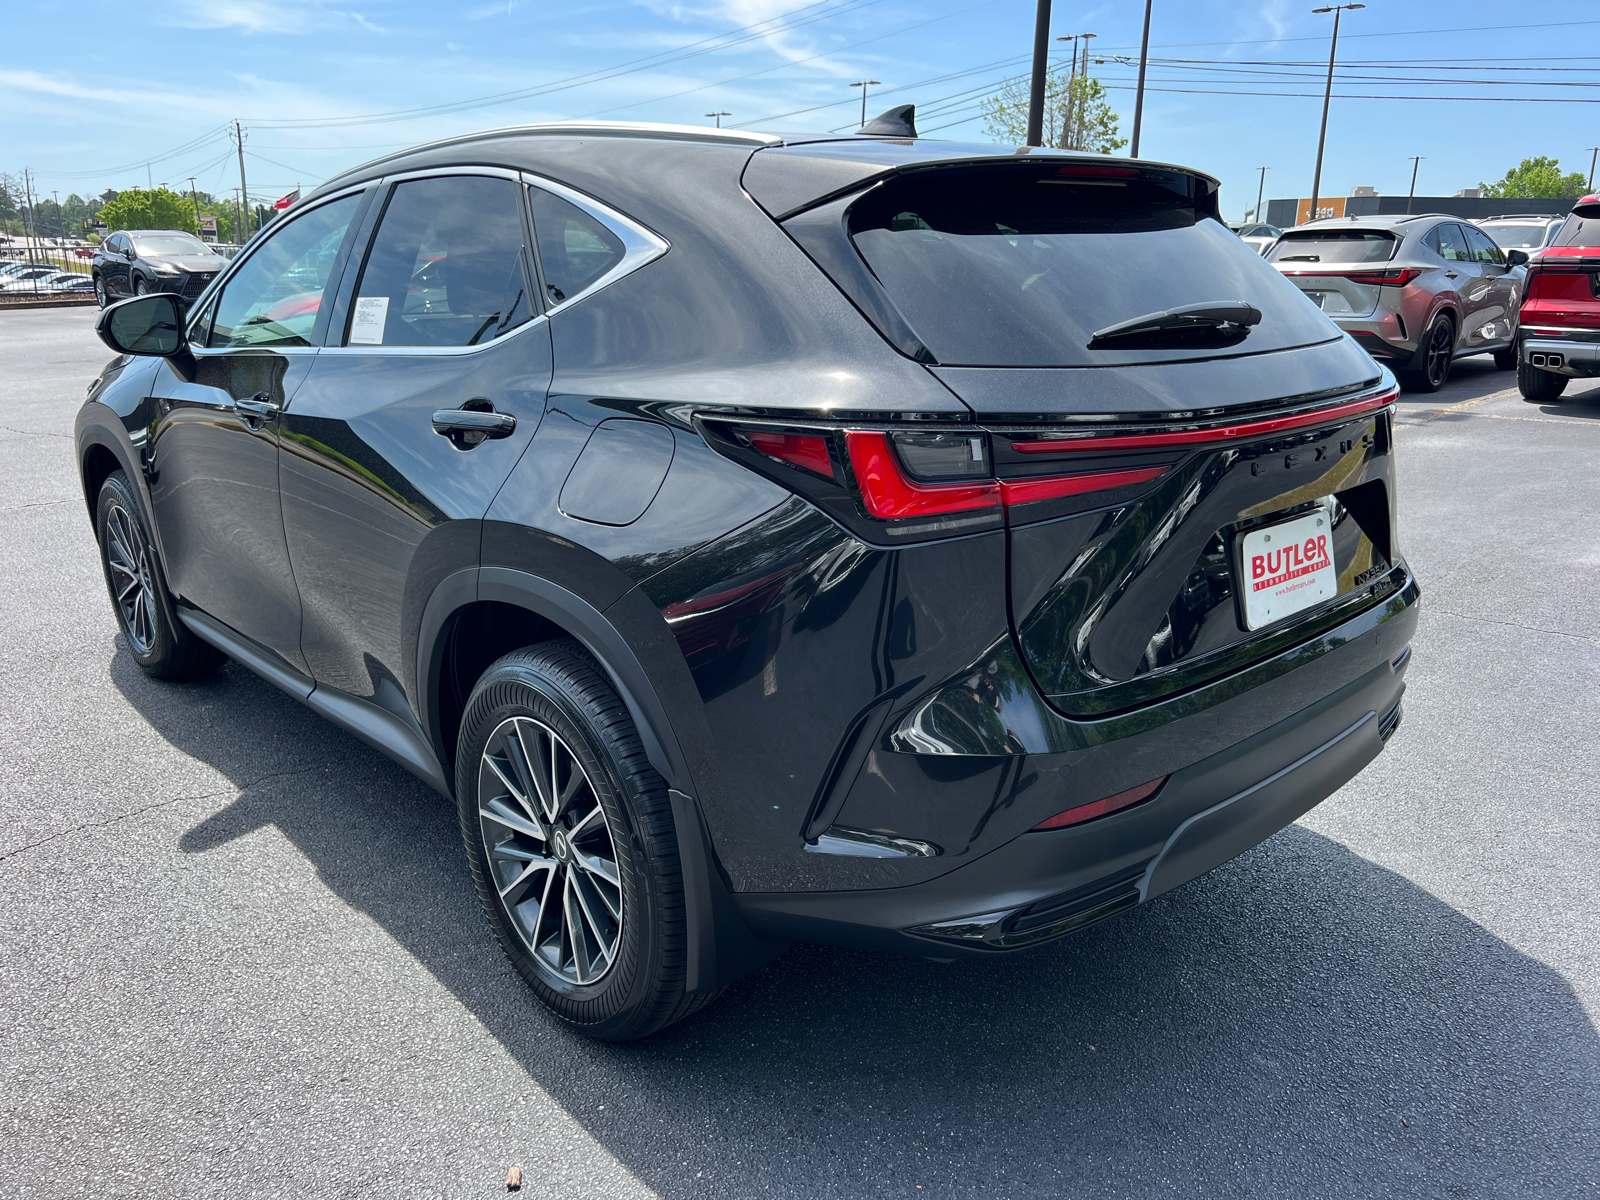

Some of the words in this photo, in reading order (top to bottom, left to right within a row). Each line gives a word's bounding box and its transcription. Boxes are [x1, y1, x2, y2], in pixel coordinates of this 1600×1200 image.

[1250, 433, 1375, 477] LEXUS
[1253, 568, 1302, 591] AUTOMOTIVE
[1308, 559, 1330, 572] GROUP
[1275, 578, 1317, 597] www.butlercars.com
